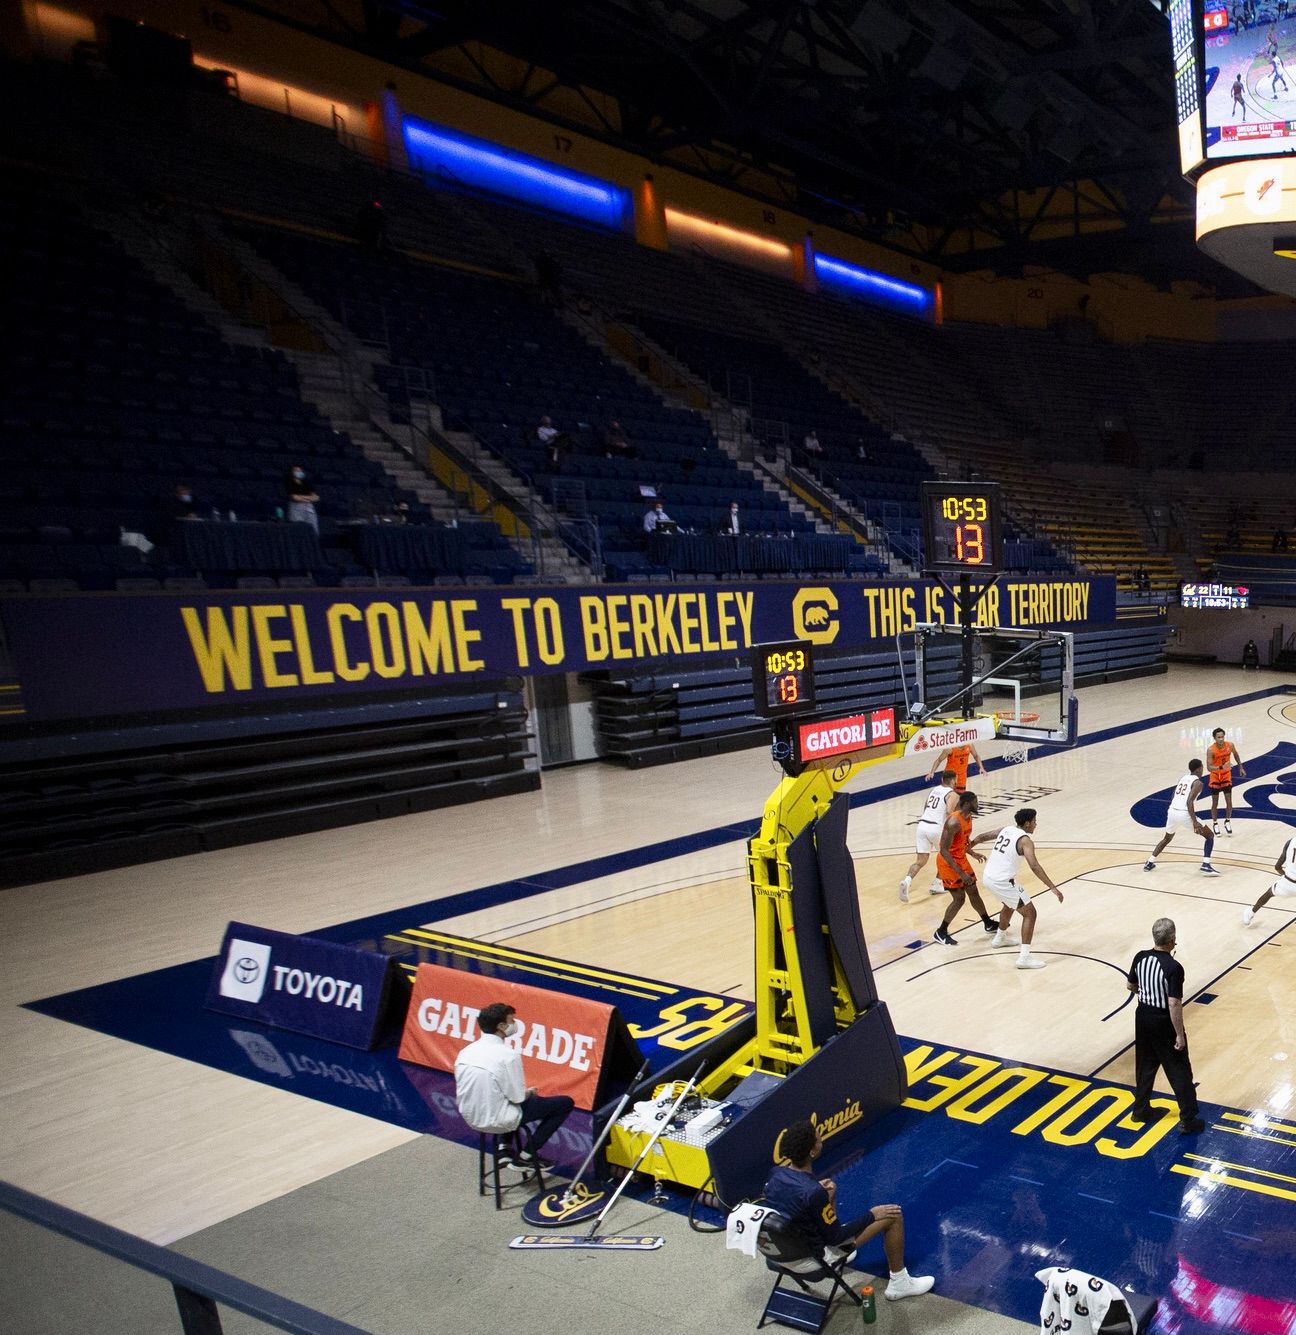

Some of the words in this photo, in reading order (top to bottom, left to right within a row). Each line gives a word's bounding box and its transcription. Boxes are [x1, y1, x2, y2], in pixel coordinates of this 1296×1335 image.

[942, 497, 987, 521] 10:53
[955, 524, 984, 565] 13
[863, 587, 917, 639] THIS
[925, 586, 945, 625] IS
[1007, 582, 1090, 627] TERRITORY
[179, 600, 485, 693] WELCOME
[501, 597, 565, 668] TO
[578, 591, 755, 662] BERKELEY
[767, 650, 805, 674] 10:53
[780, 675, 798, 702] 13
[926, 795, 940, 810] 20
[1175, 783, 1188, 796] 32
[994, 835, 1011, 854] 22
[756, 887, 785, 899] SPALDING
[273, 965, 364, 1012] TOYOTA
[417, 997, 595, 1071] GATRADE
[900, 1044, 1182, 1160] GOLDEN
[772, 1097, 864, 1168] Cornia
[1088, 1277, 1104, 1293] G
